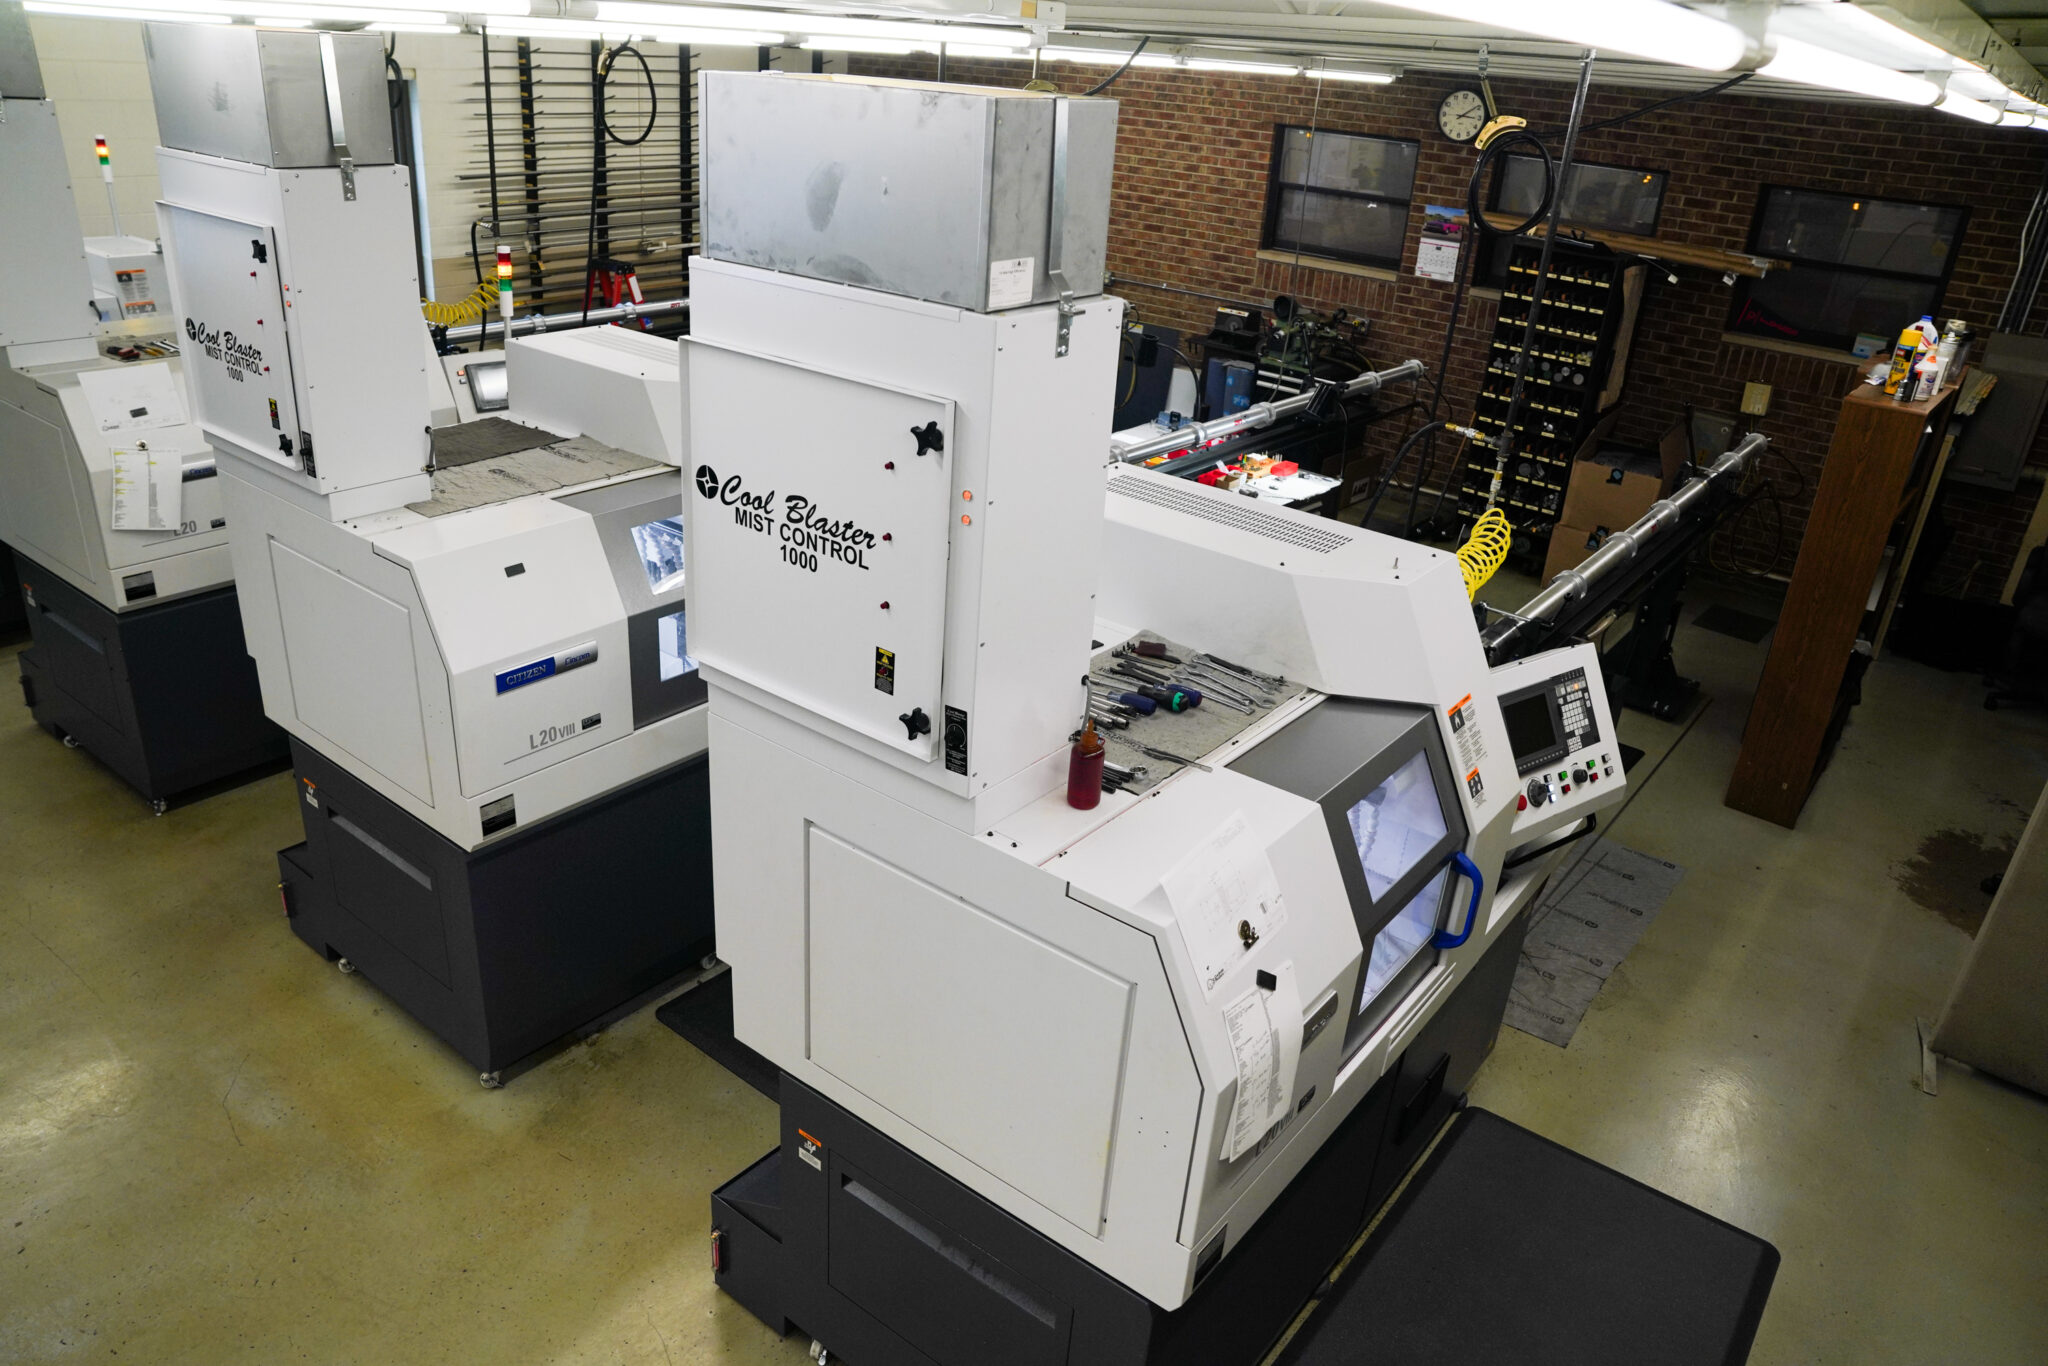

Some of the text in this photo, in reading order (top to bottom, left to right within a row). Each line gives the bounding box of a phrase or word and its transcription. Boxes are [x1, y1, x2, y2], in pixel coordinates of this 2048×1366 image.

[197, 322, 263, 362] Cool Blaster
[204, 343, 263, 376] MIST CONTROL
[226, 365, 244, 383] 1000
[720, 475, 876, 549] Cool Blaster
[735, 507, 869, 570] MIST CONTROL
[780, 544, 818, 572] 1000
[506, 664, 547, 686] CITIZEN
